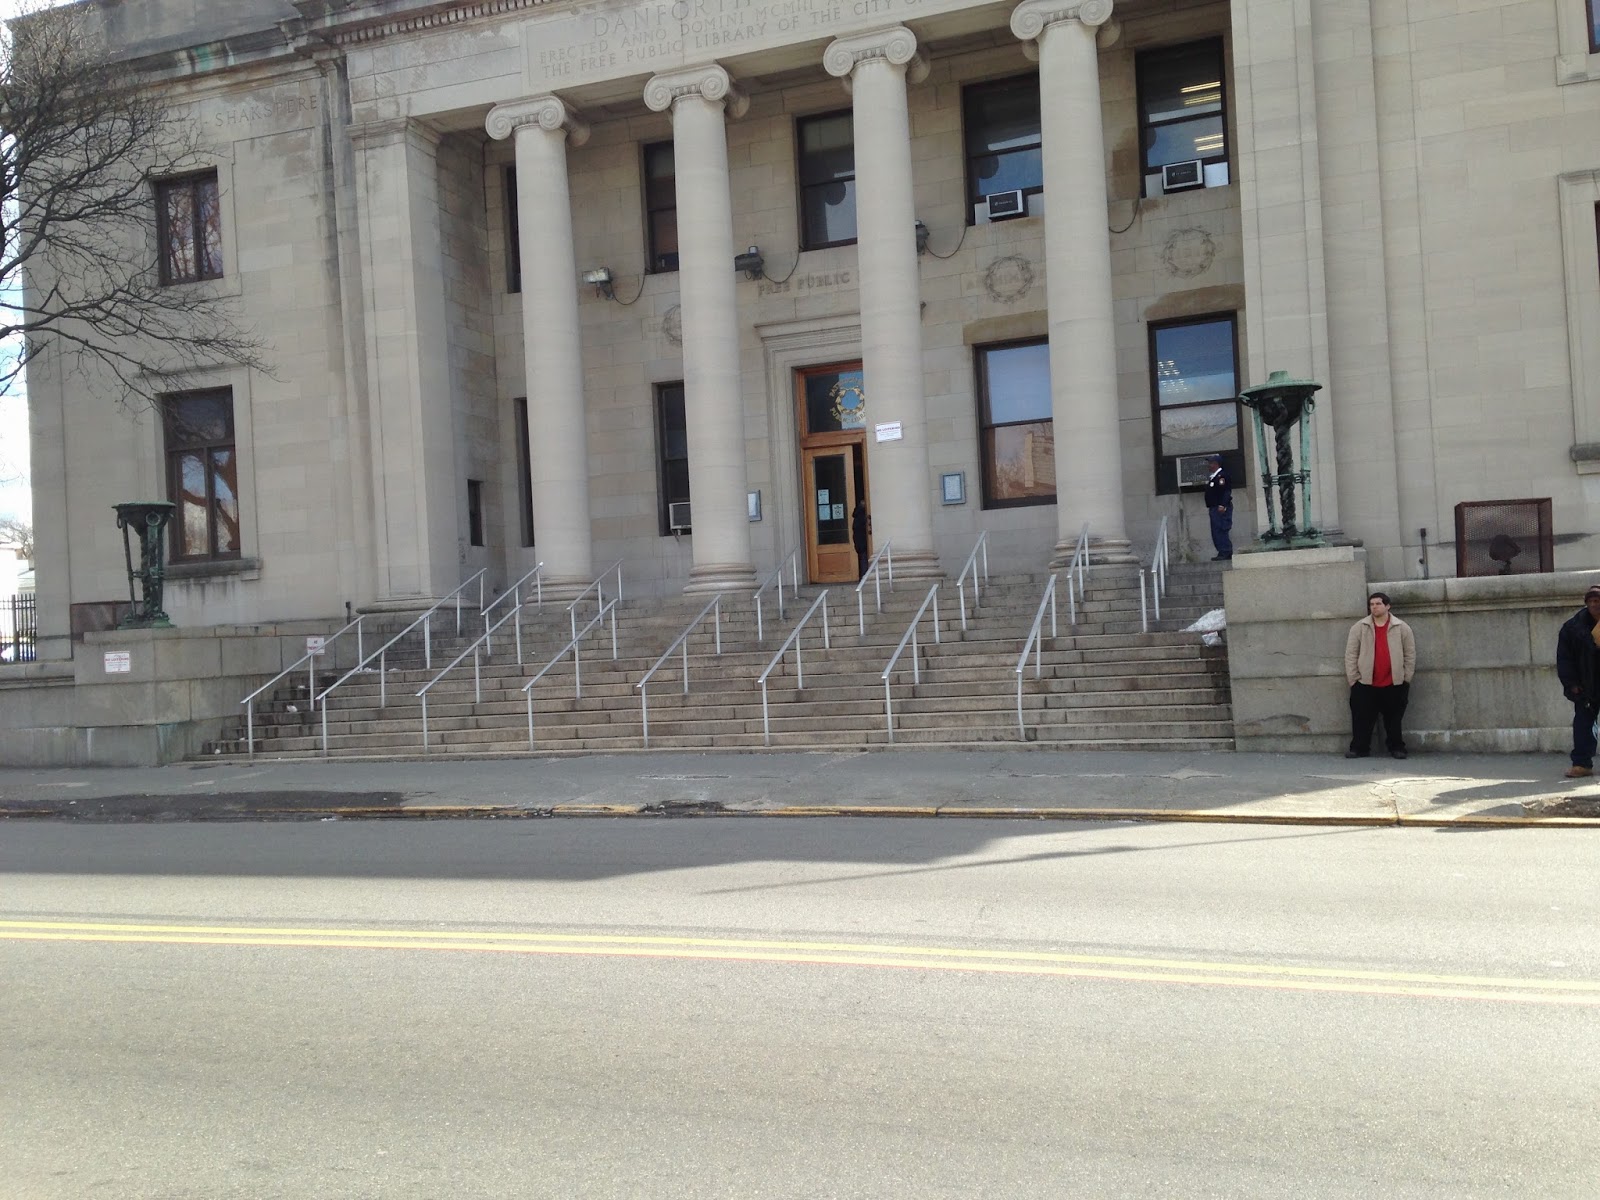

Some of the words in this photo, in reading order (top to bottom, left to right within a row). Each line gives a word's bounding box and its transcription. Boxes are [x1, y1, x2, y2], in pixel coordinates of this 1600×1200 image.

[540, 40, 609, 64] ERECTED
[621, 29, 667, 48] ANNO
[680, 12, 744, 37] DOMINI
[541, 61, 570, 78] THE
[580, 53, 617, 71] FREE
[626, 40, 682, 62] PUBLIC
[695, 22, 767, 48] LIBRARY
[778, 15, 799, 31] OF
[810, 7, 841, 25] THE
[853, 0, 892, 16] CITY
[215, 95, 318, 127] SHAKSPERE
[797, 271, 851, 290] PUBLIC
